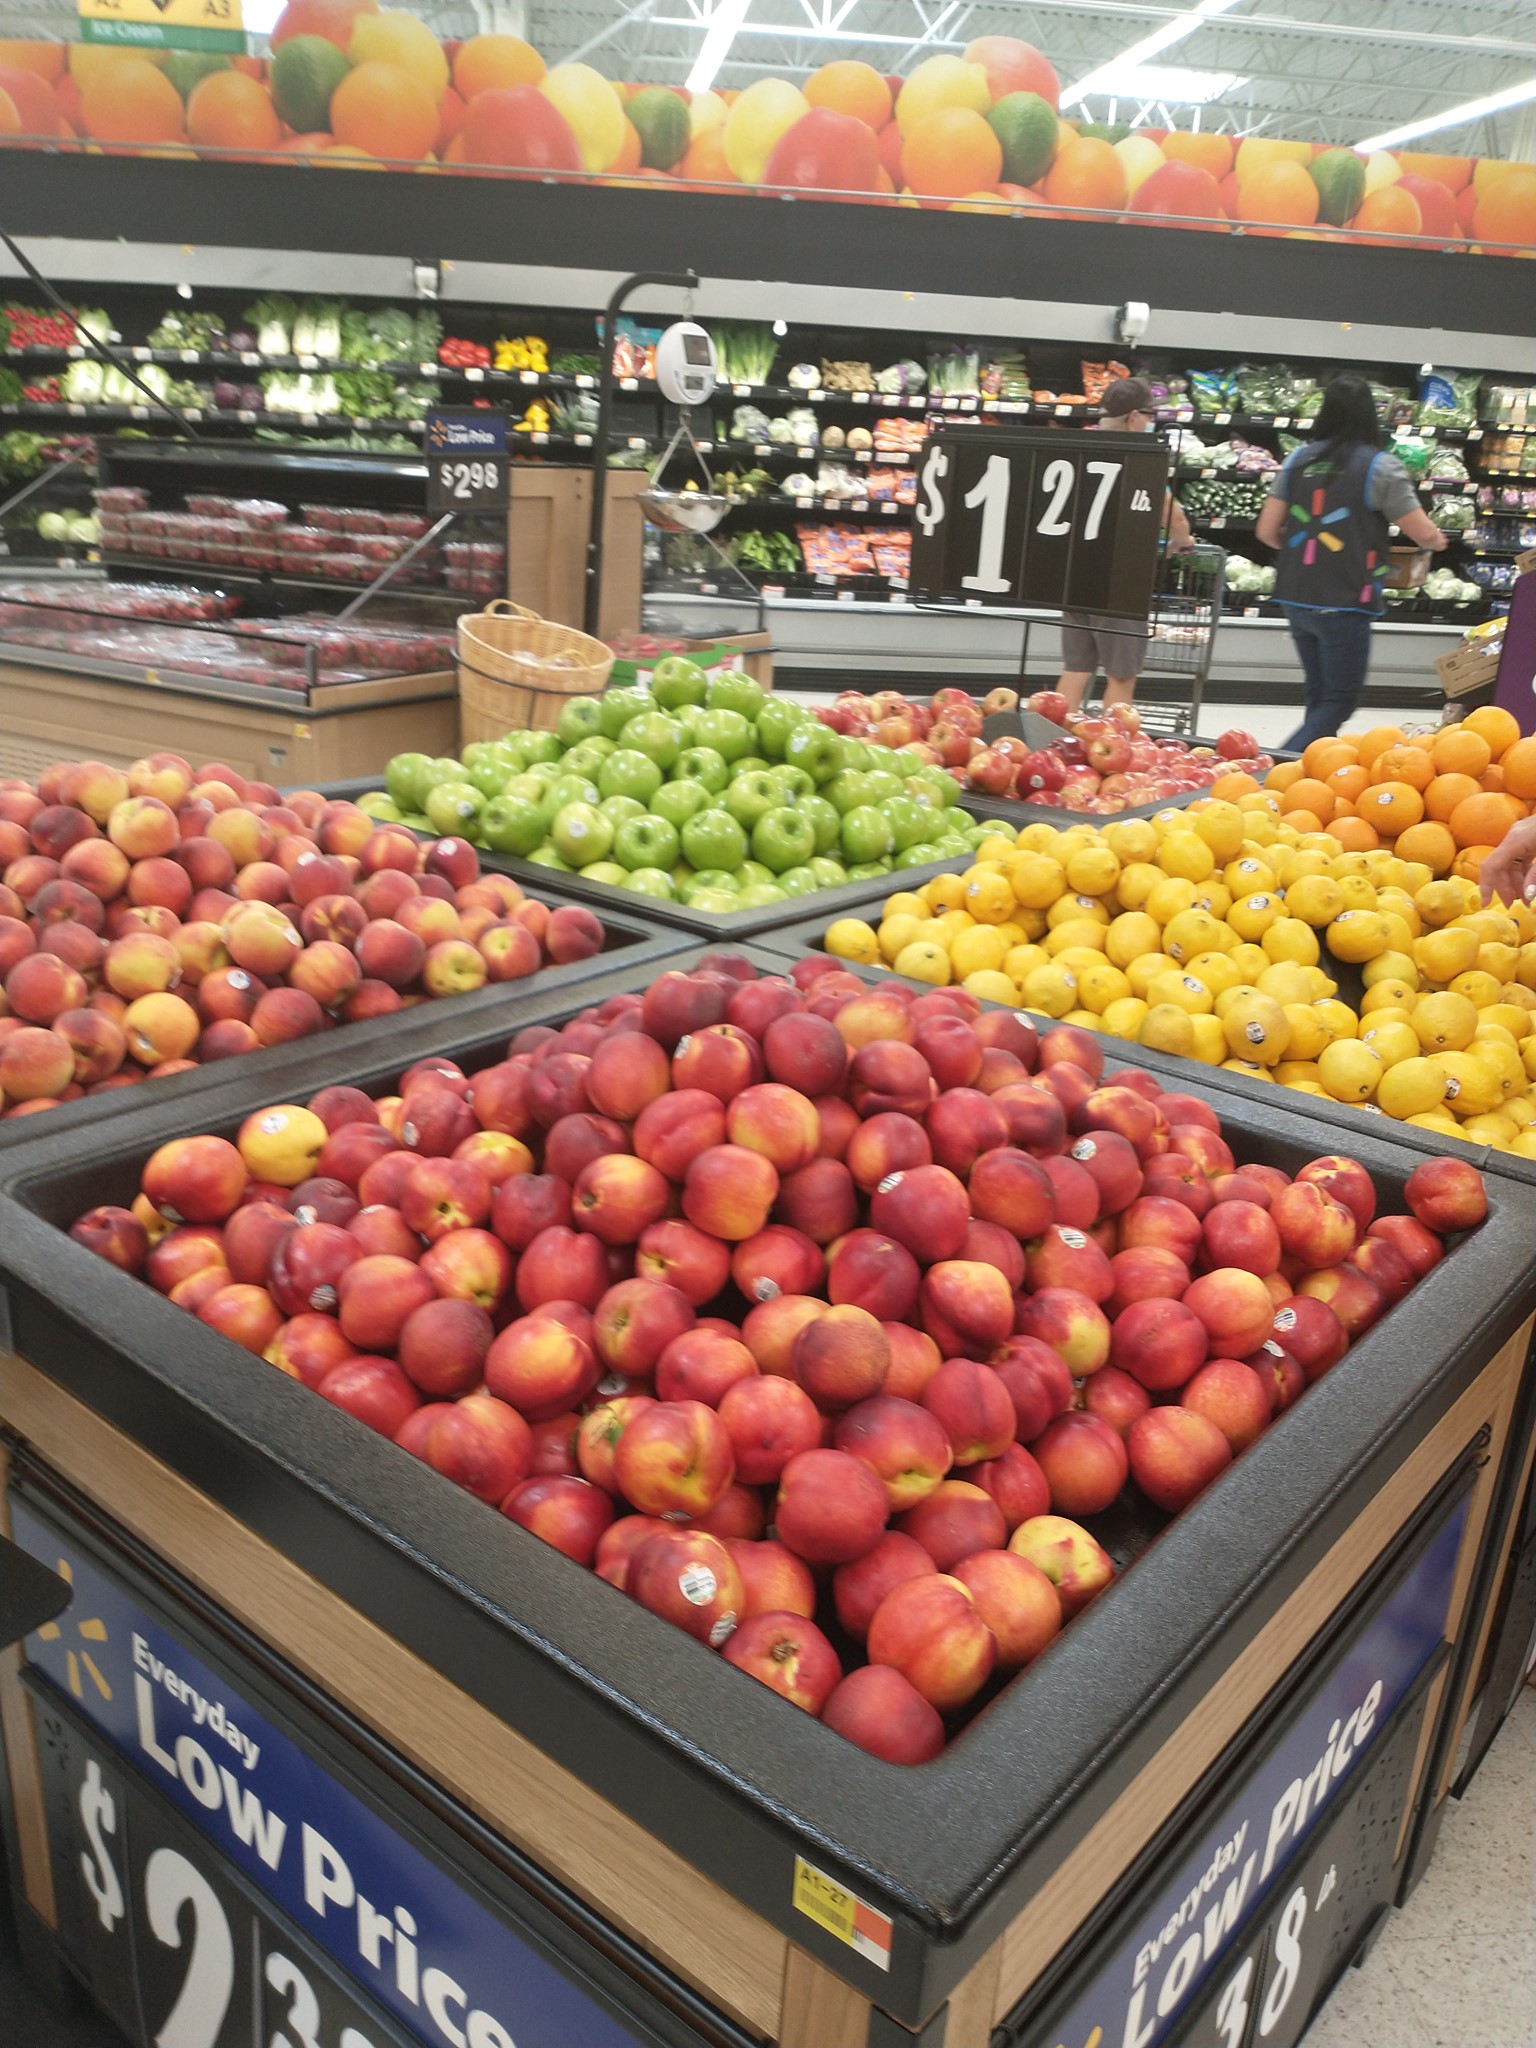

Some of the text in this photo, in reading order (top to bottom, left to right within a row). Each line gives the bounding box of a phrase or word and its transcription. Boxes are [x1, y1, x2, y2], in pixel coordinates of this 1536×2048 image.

[440, 462, 499, 498] $298
[131, 1631, 261, 1771] Everyday
[134, 1671, 288, 1872] Low
[800, 1868, 848, 1907] A1-27
[1122, 1680, 1384, 2048] Low Price
[1132, 1819, 1249, 1988] Everyday
